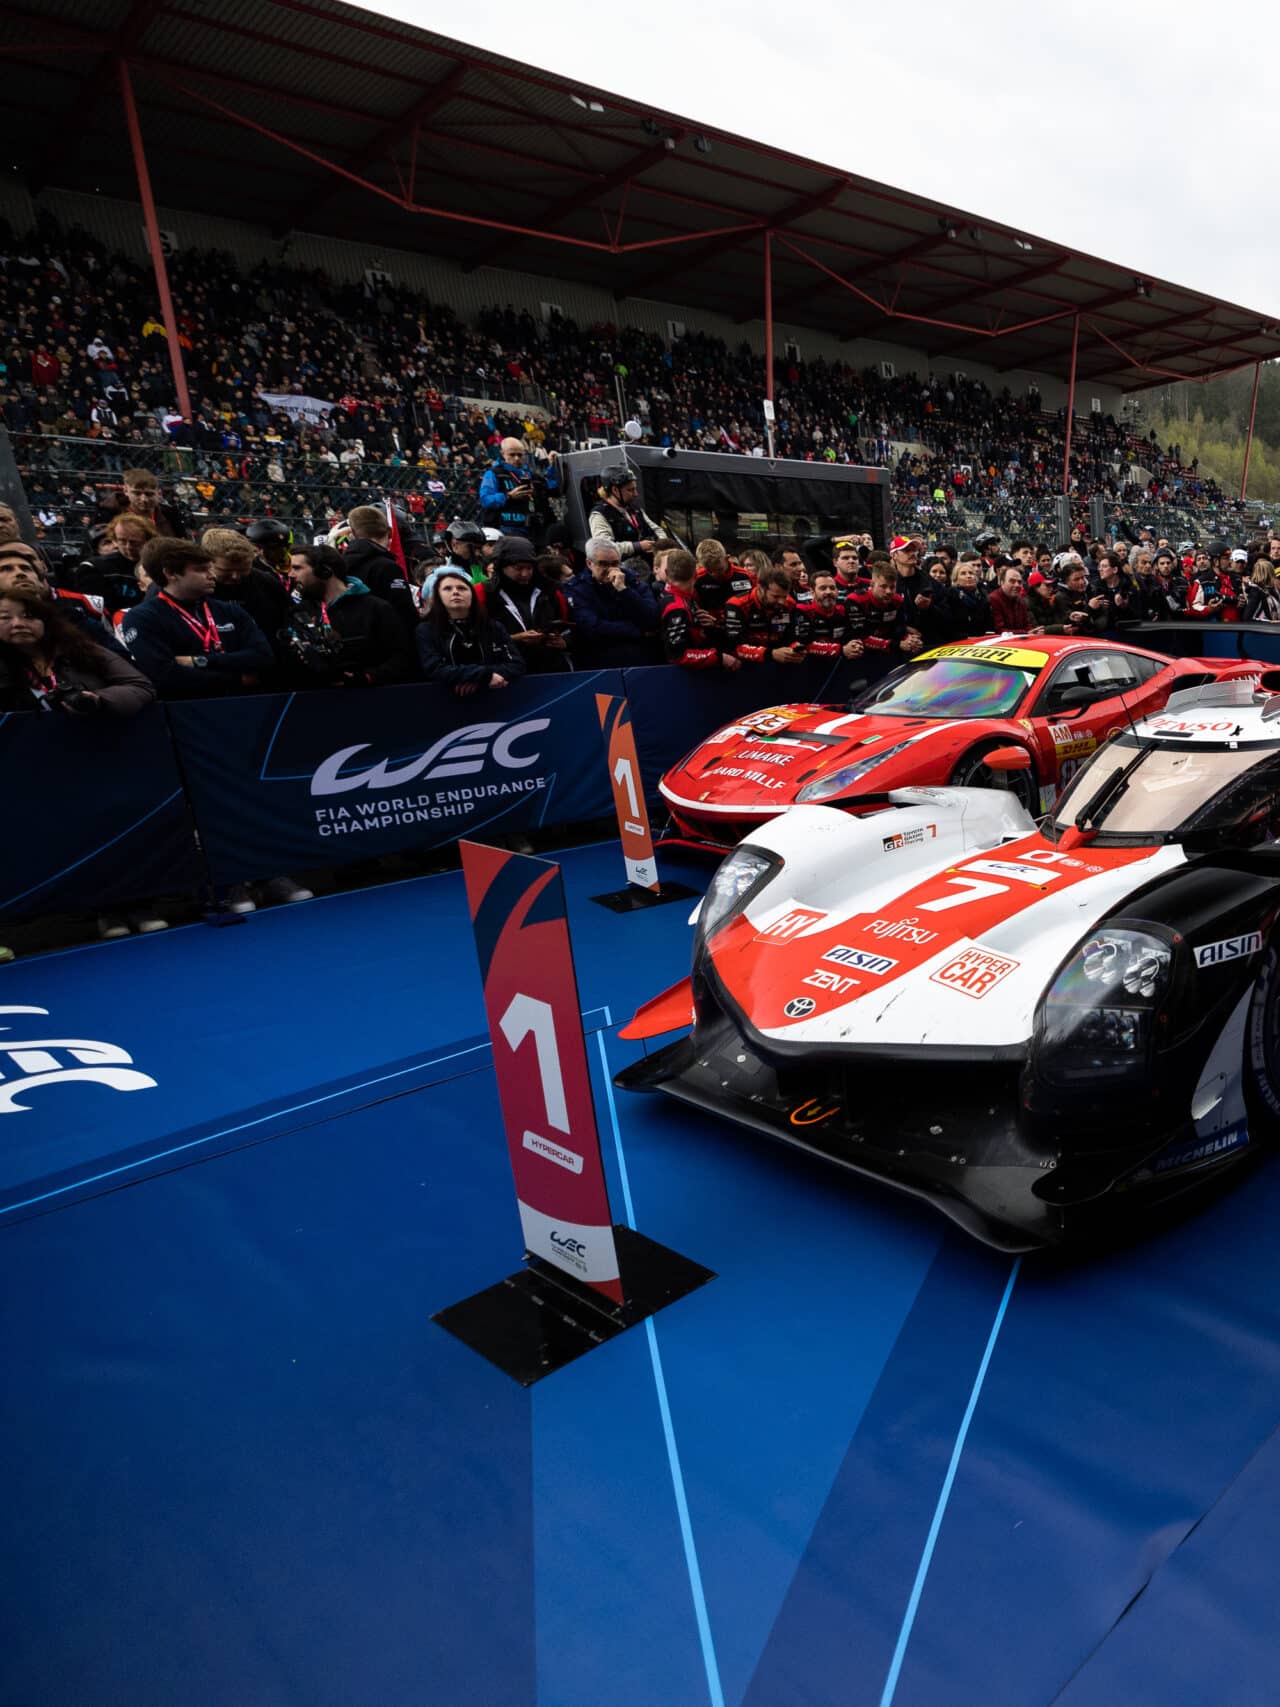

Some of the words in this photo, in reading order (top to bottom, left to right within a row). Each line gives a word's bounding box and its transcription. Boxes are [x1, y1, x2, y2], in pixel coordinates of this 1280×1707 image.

[928, 646, 1017, 662] Ferrari
[741, 713, 788, 731] 83
[1054, 726, 1072, 742] AM
[311, 718, 551, 796] WEC
[315, 808, 352, 822] FIA
[356, 794, 430, 818] WORLD
[436, 777, 546, 804] ENDURANCE
[614, 758, 640, 819] 1
[318, 802, 475, 836] CHAMPIONSHIP
[927, 824, 937, 838] 7
[885, 838, 904, 851] GR
[915, 877, 1010, 912] 7
[764, 913, 816, 938] HY
[862, 918, 939, 945] FUJITSU
[825, 948, 893, 973] AISIN
[959, 950, 1012, 975] HYPER
[1199, 933, 1261, 966] AISIN
[801, 968, 861, 994] ZENT
[940, 962, 997, 994] CAR
[500, 992, 570, 1135] 1
[531, 1138, 575, 1166] HYPERCAR
[1156, 1131, 1238, 1170] MICHELIN
[550, 1231, 587, 1258] WEC
